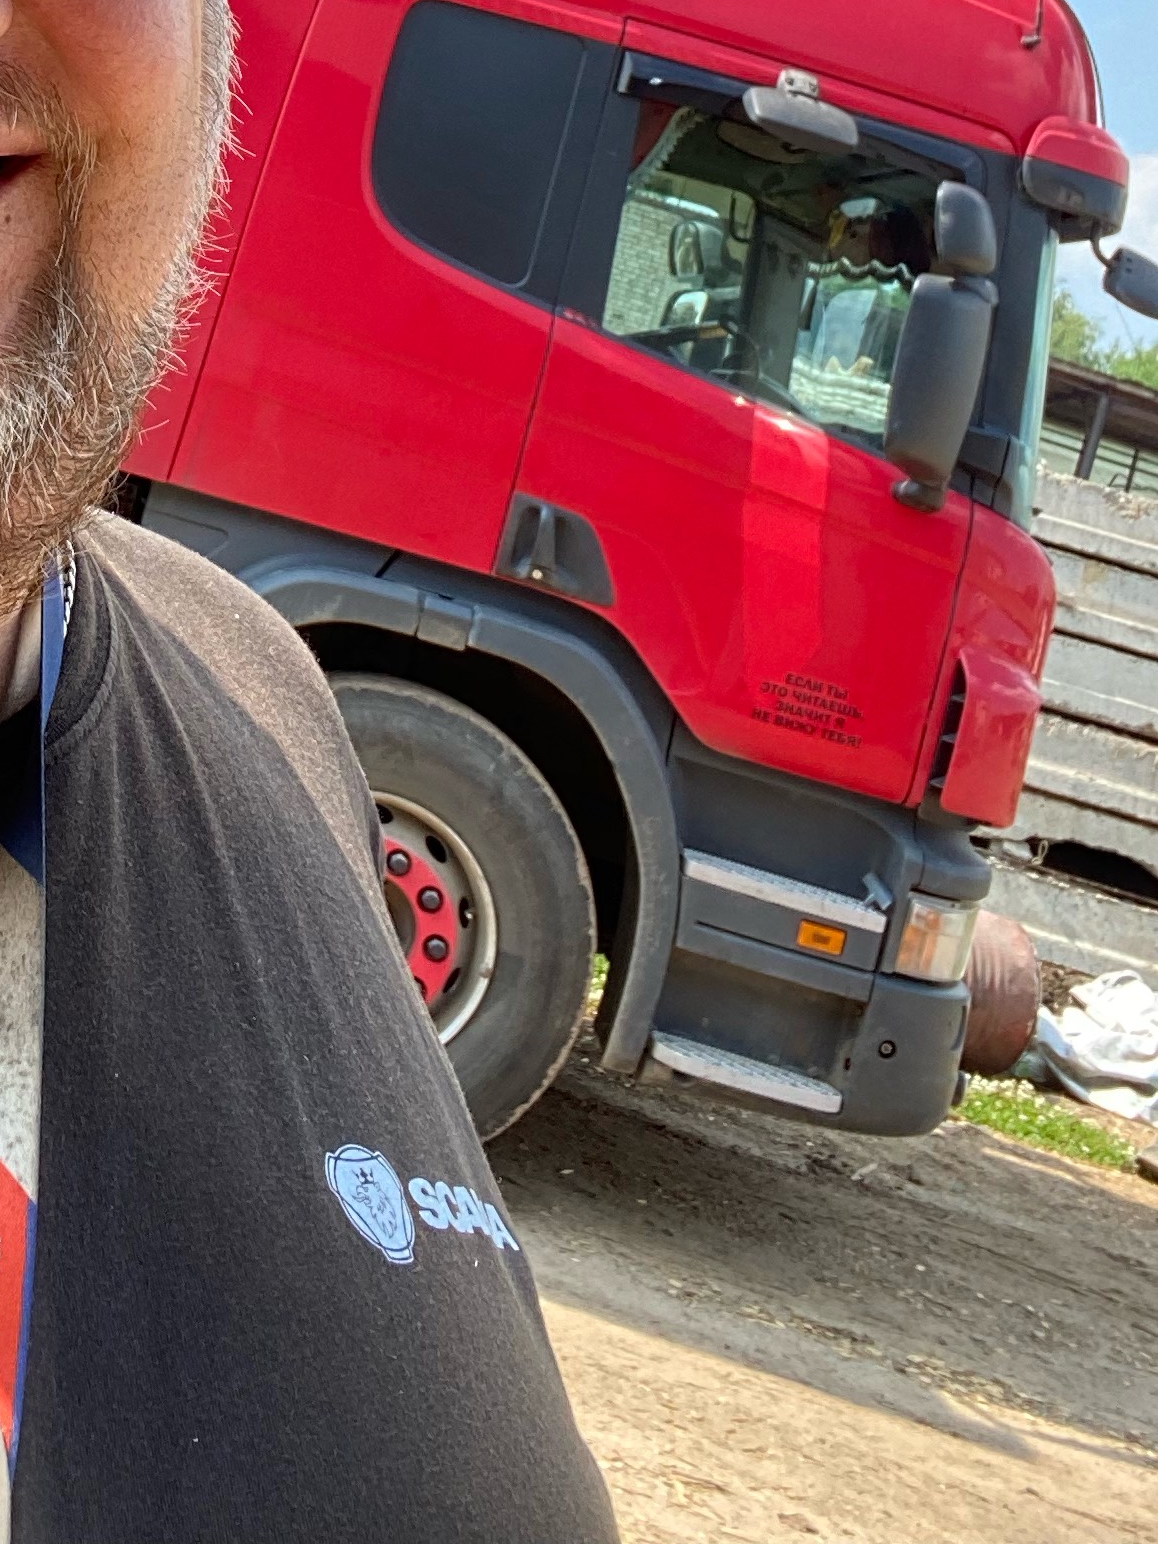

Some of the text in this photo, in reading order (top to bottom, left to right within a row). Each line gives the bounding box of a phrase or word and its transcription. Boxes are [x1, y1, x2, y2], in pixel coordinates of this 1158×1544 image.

[760, 681, 788, 697] ЭТО
[785, 672, 849, 700] ЕСЛИ ТЫ
[751, 707, 771, 723] НЕ
[774, 713, 817, 735] ВИЖУ
[775, 700, 846, 728] ЗНАЧИТ Я
[408, 1177, 520, 1251] SCAA
